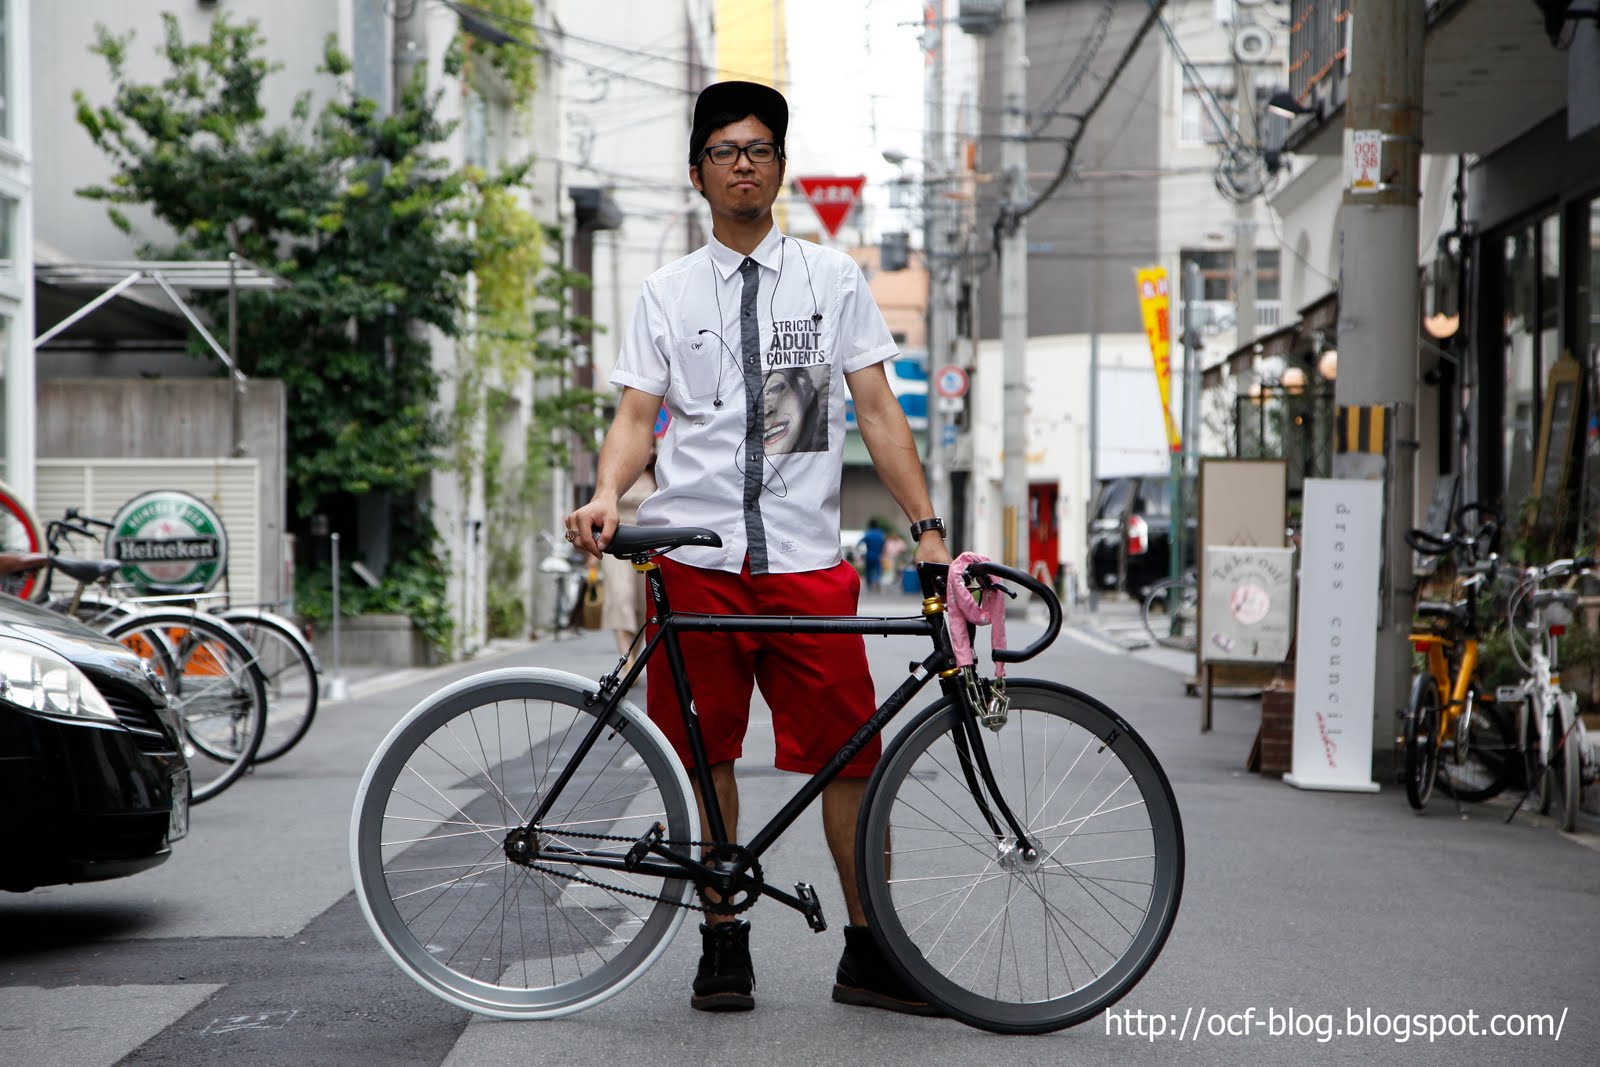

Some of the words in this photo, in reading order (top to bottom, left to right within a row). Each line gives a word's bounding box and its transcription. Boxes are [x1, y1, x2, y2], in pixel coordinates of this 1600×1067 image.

[772, 320, 819, 333] STRICTLY
[769, 332, 821, 351] ADULT
[766, 350, 825, 366] CONTENTS
[120, 541, 214, 559] Heineken
[1333, 503, 1351, 590] dress
[1212, 554, 1254, 580] Take
[1327, 617, 1343, 735] council
